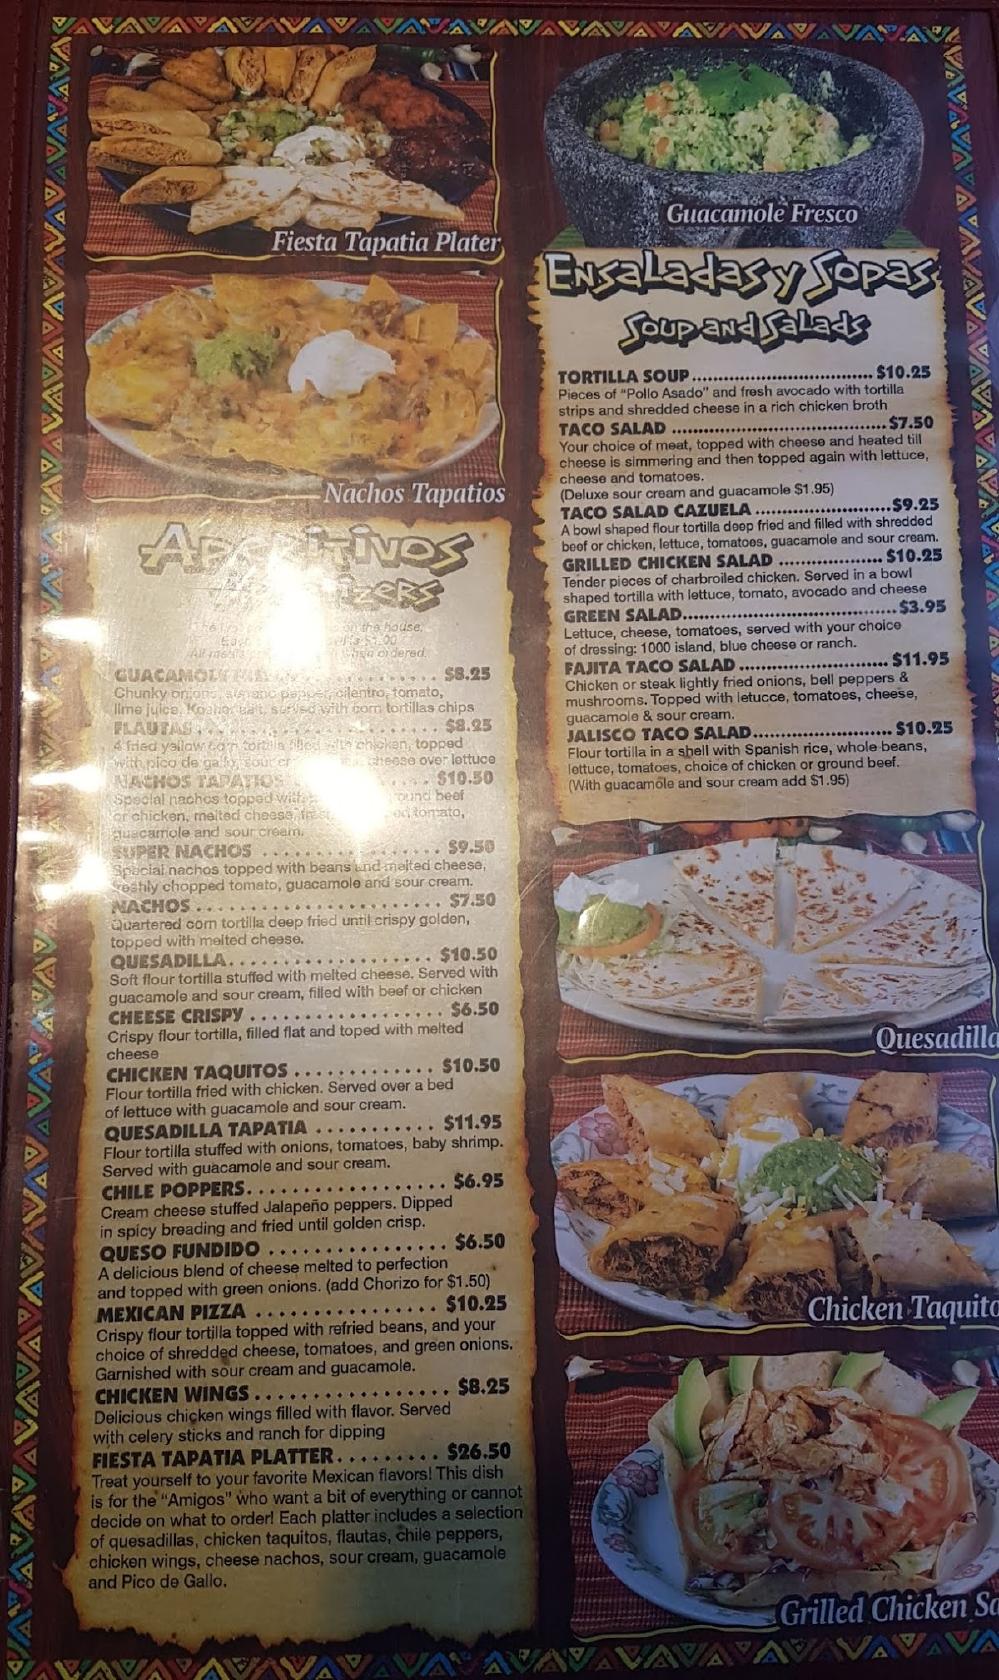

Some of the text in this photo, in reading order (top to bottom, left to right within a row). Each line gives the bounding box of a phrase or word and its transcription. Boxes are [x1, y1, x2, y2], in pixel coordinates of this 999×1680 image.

[667, 203, 858, 223] Guacamole Fresco
[272, 230, 501, 256] Fiesta Tapatia Plater
[558, 364, 930, 384] TORTILLA SOUP $10.25
[559, 399, 887, 418] strips and shredded cheese in a rich chicken broth
[559, 415, 933, 436] TACO SALAD $7.50
[324, 482, 506, 508] Nachos Tapatios
[560, 497, 939, 519] TACO SALAD CAZUELA $9.25
[562, 548, 942, 571] GRILLED CHICKEN SALAD $10.25
[562, 576, 605, 587] Tender
[610, 577, 651, 588] pieces
[655, 574, 667, 585] of
[671, 572, 743, 584] charbroiled
[747, 571, 799, 582] chicken.
[804, 569, 848, 581] Served
[881, 567, 911, 578] bowl
[564, 599, 946, 622] GREEN SALAD $3.95
[564, 636, 856, 656] of dressing: 1000 island, blue cheese or ranch.
[445, 666, 490, 681] $8.25
[565, 651, 949, 675] FAJITA TACO SALAD $11.95
[446, 718, 491, 733] $8.25
[567, 721, 953, 742] JALISCO TACO SALAD $10.25
[437, 770, 493, 785] $10.50
[569, 773, 849, 792] (With guacamole and sour cream add $1.95)
[112, 839, 494, 859] SUPER NACHOS $9.50
[111, 892, 495, 914] NACHOS $7.50
[110, 947, 497, 970] QUESADILLA $10.50
[110, 965, 497, 985] Soft flour tortilla stuffed with melted cheese. Served with
[108, 1001, 498, 1025] CHEESE CRISPY $6.50
[106, 1058, 500, 1082] CHICKEN TAQUITOS $10.50
[104, 1114, 501, 1142] QUESADILLA TAPATIA $11.95
[102, 1172, 503, 1200] CHILE POPPERS $6.95
[100, 1216, 425, 1240] in spicy breading and fried until golden crisp.
[100, 1233, 505, 1262] QUESO FUNDIDO $6.50
[96, 1295, 506, 1322] MEXICAN PIZZA $10.25
[808, 1295, 903, 1321] Chicken
[96, 1339, 512, 1361] choice of shredded cheese, tomatoes, and green onions.
[95, 1377, 509, 1404] CHICKEN WINGS $8.25
[93, 1424, 384, 1445] with celery sticks and ranch for dipping
[93, 1442, 510, 1468] FIESTA TAPATIA PLATTER $26.50
[88, 1573, 226, 1588] and Pico de Gallo.
[780, 1597, 864, 1625] Grilled
[871, 1594, 968, 1622] Chicken
